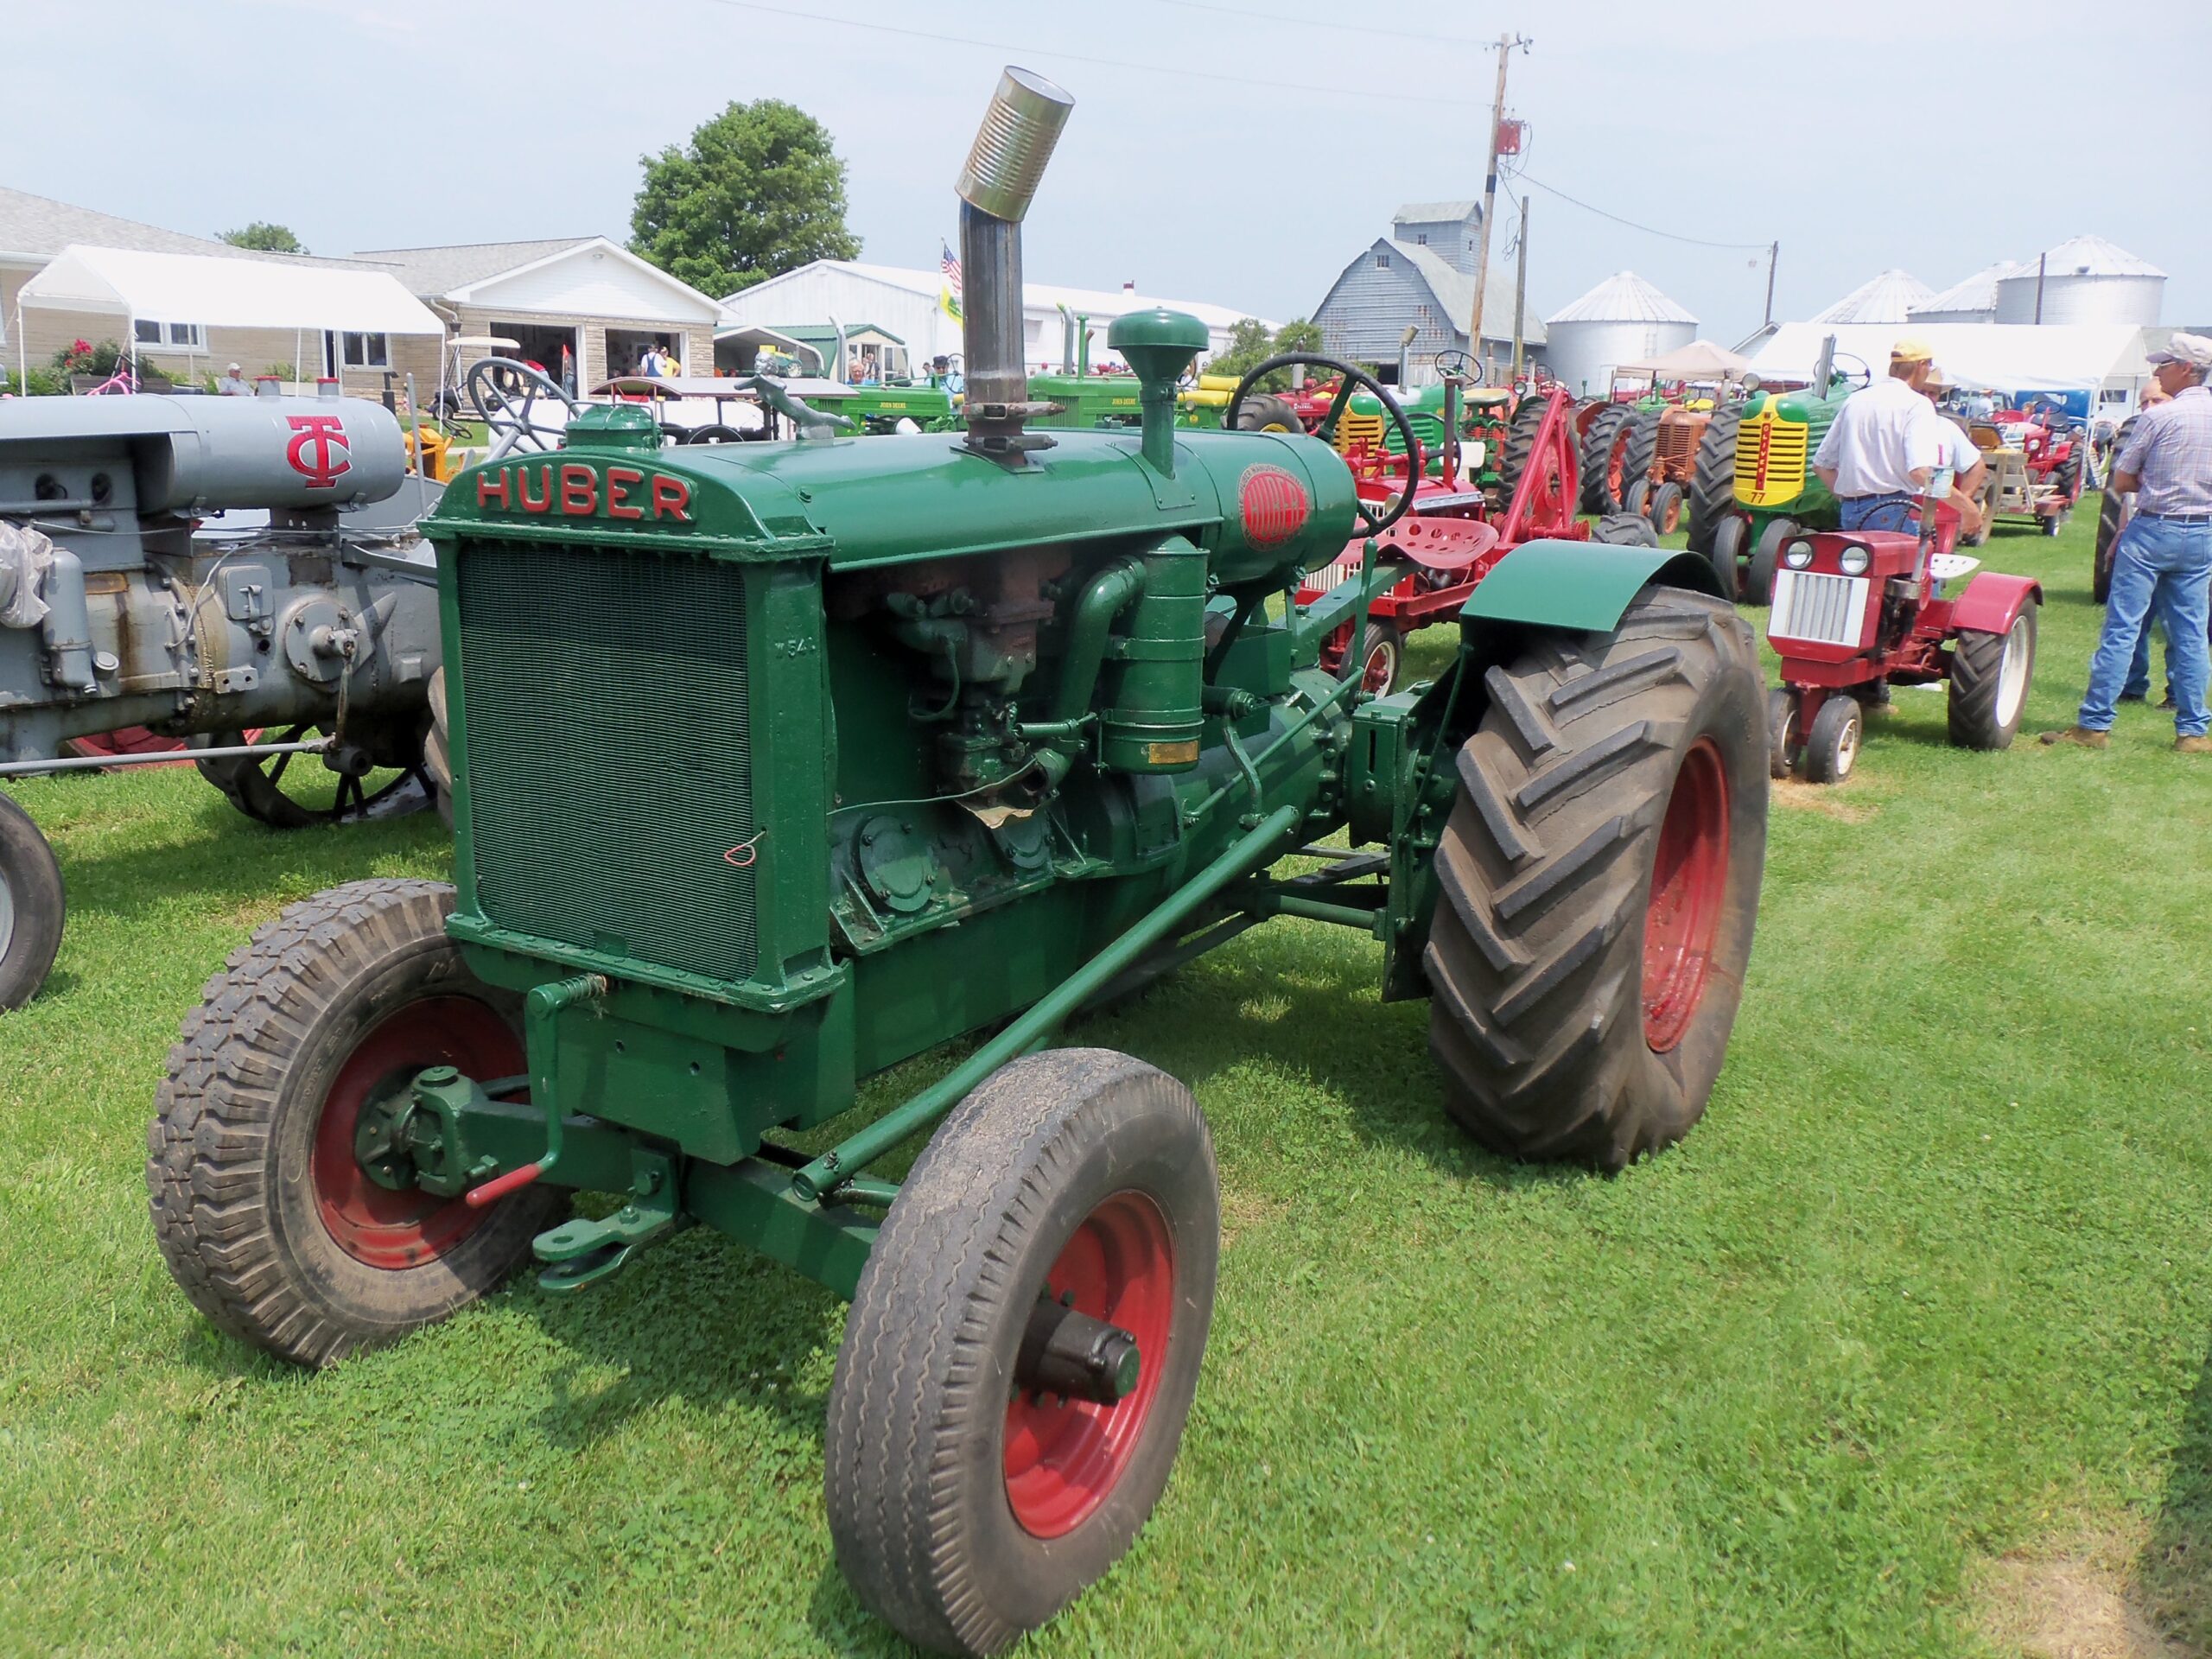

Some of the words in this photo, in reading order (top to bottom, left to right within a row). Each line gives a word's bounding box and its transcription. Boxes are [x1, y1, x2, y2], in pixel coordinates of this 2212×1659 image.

[1758, 424, 1770, 474] OLIVER
[477, 462, 693, 523] HUBER
[1247, 475, 1306, 538] HUBER
[1750, 492, 1765, 504] 77
